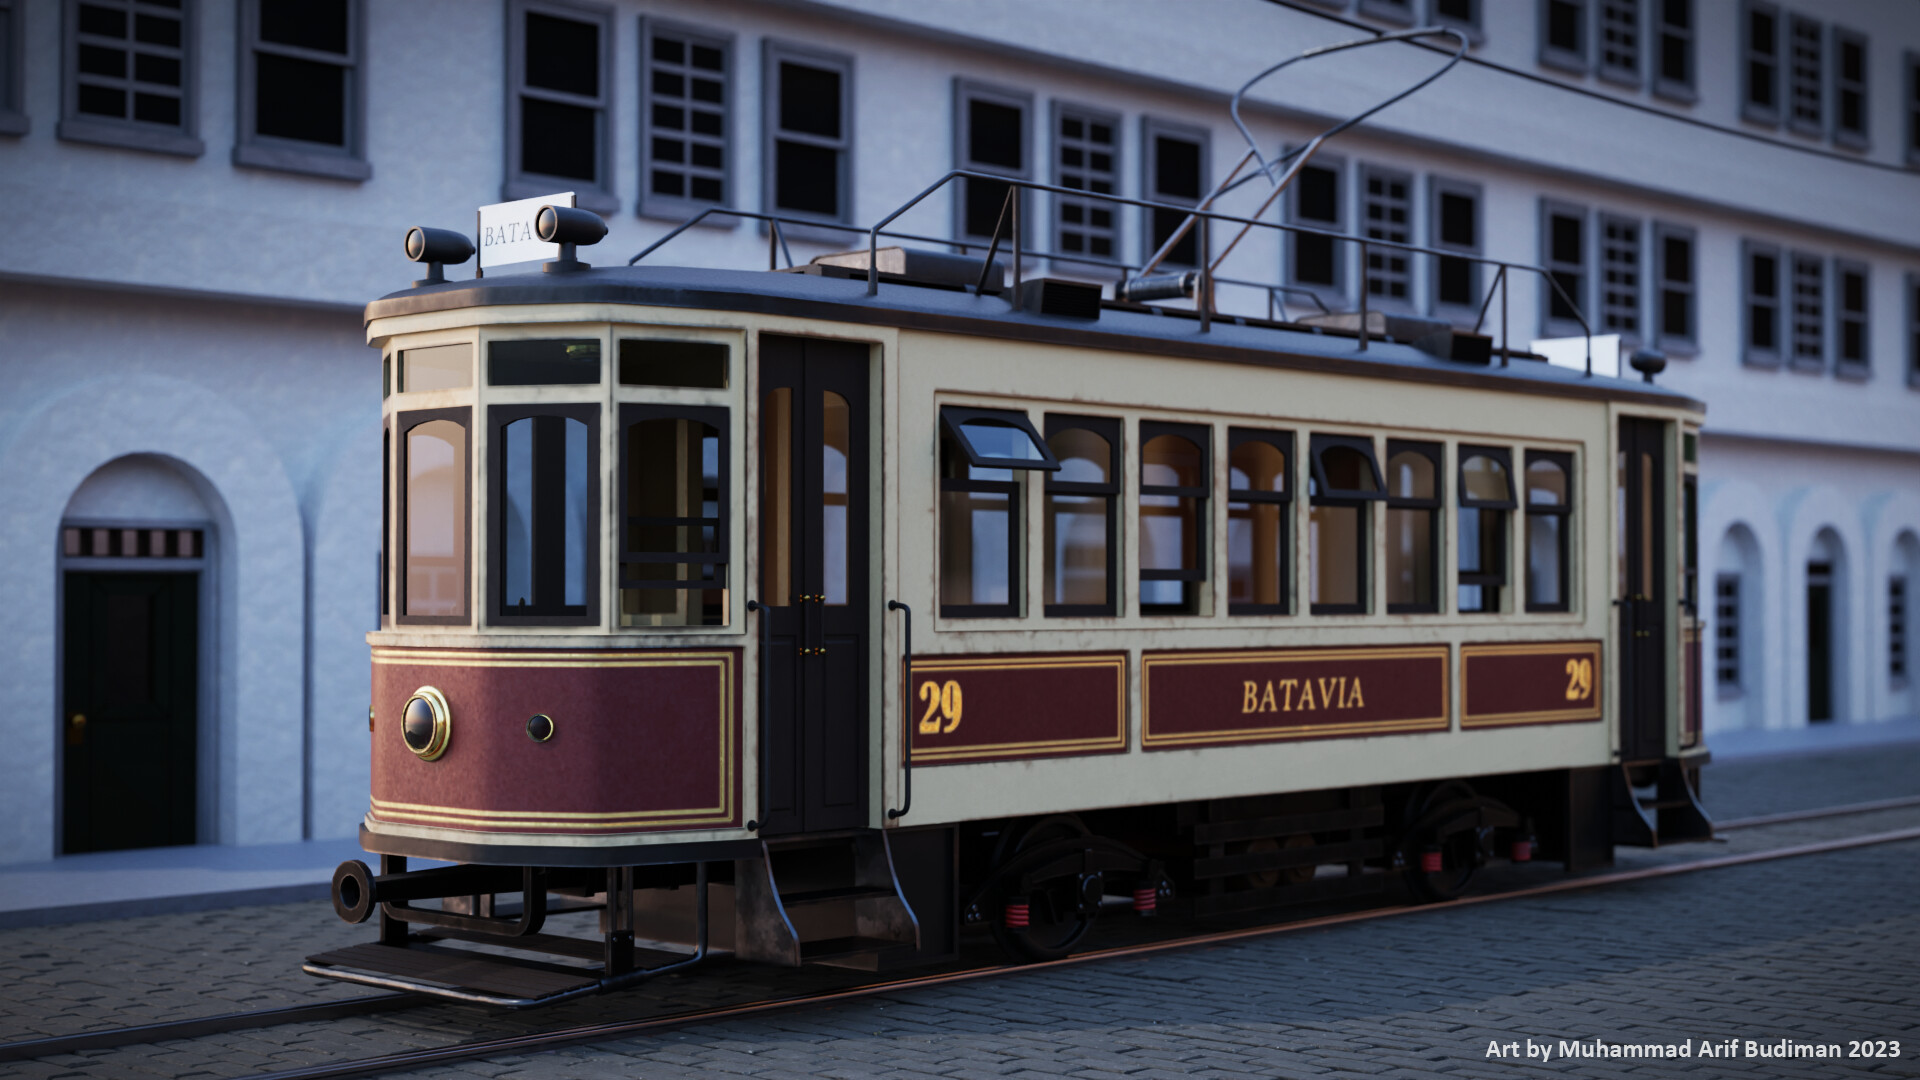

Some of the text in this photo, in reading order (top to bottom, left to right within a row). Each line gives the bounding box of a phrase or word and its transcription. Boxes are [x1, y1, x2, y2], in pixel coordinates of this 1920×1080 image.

[484, 220, 532, 247] BATA
[1242, 676, 1365, 714] BATAVIA
[1565, 658, 1592, 700] 29
[919, 680, 963, 734] 29
